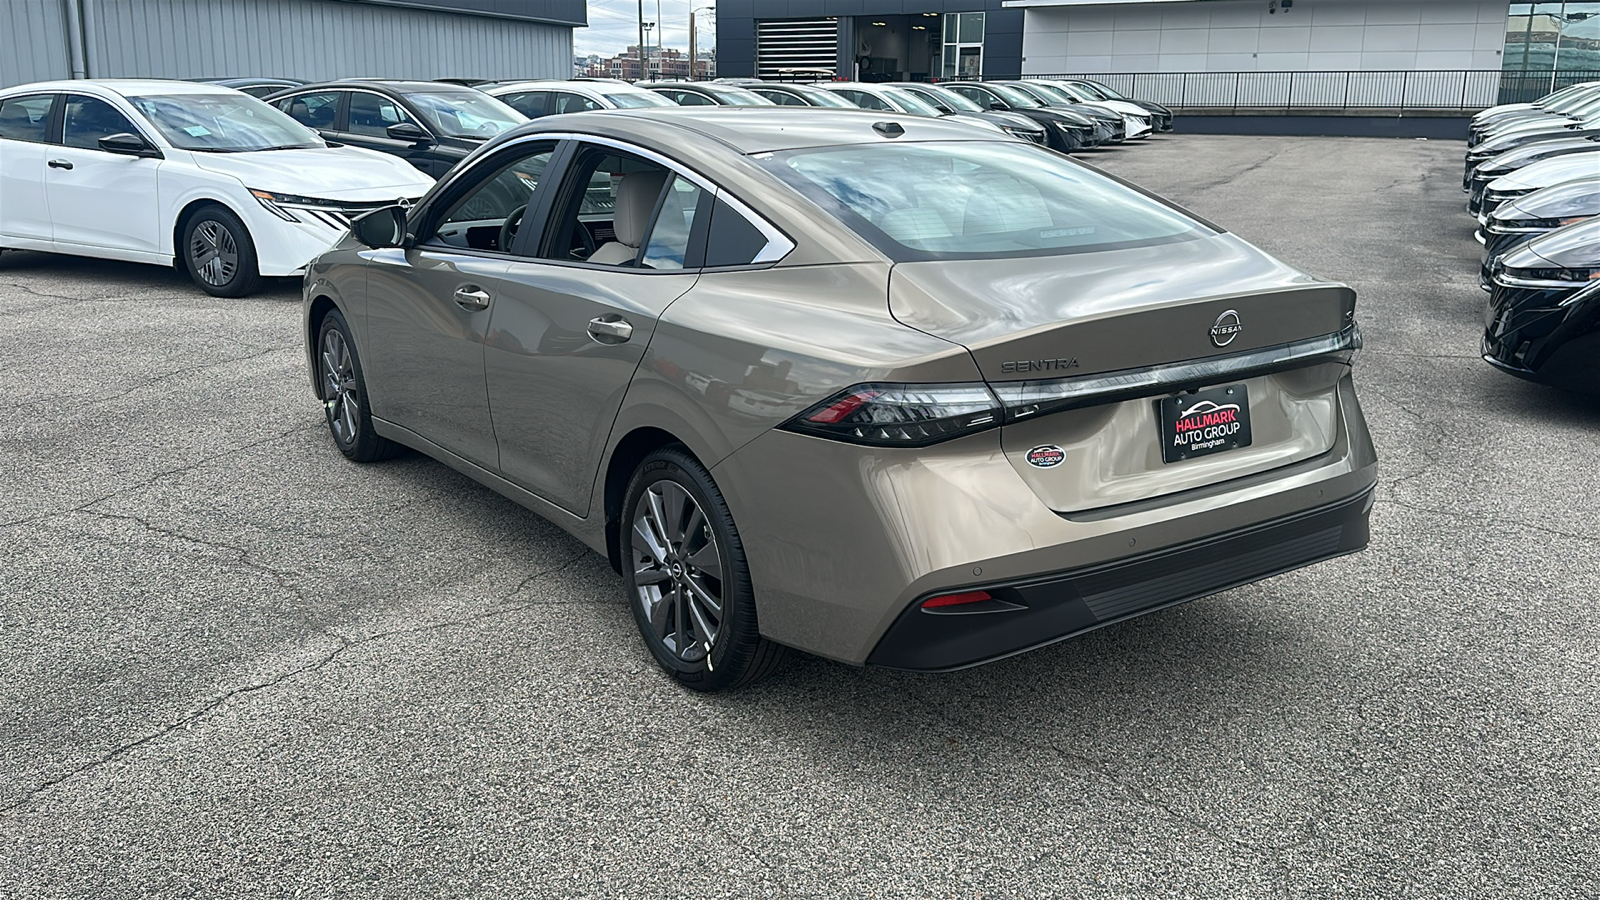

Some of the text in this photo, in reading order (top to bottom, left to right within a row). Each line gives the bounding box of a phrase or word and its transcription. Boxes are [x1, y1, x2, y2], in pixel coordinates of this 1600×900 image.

[1210, 325, 1242, 335] NISSAN
[1001, 357, 1079, 374] SENTRA
[1176, 409, 1236, 433] HALLMARK
[1174, 422, 1240, 447] AUTO GROUP
[1191, 438, 1225, 451] Birmingham
